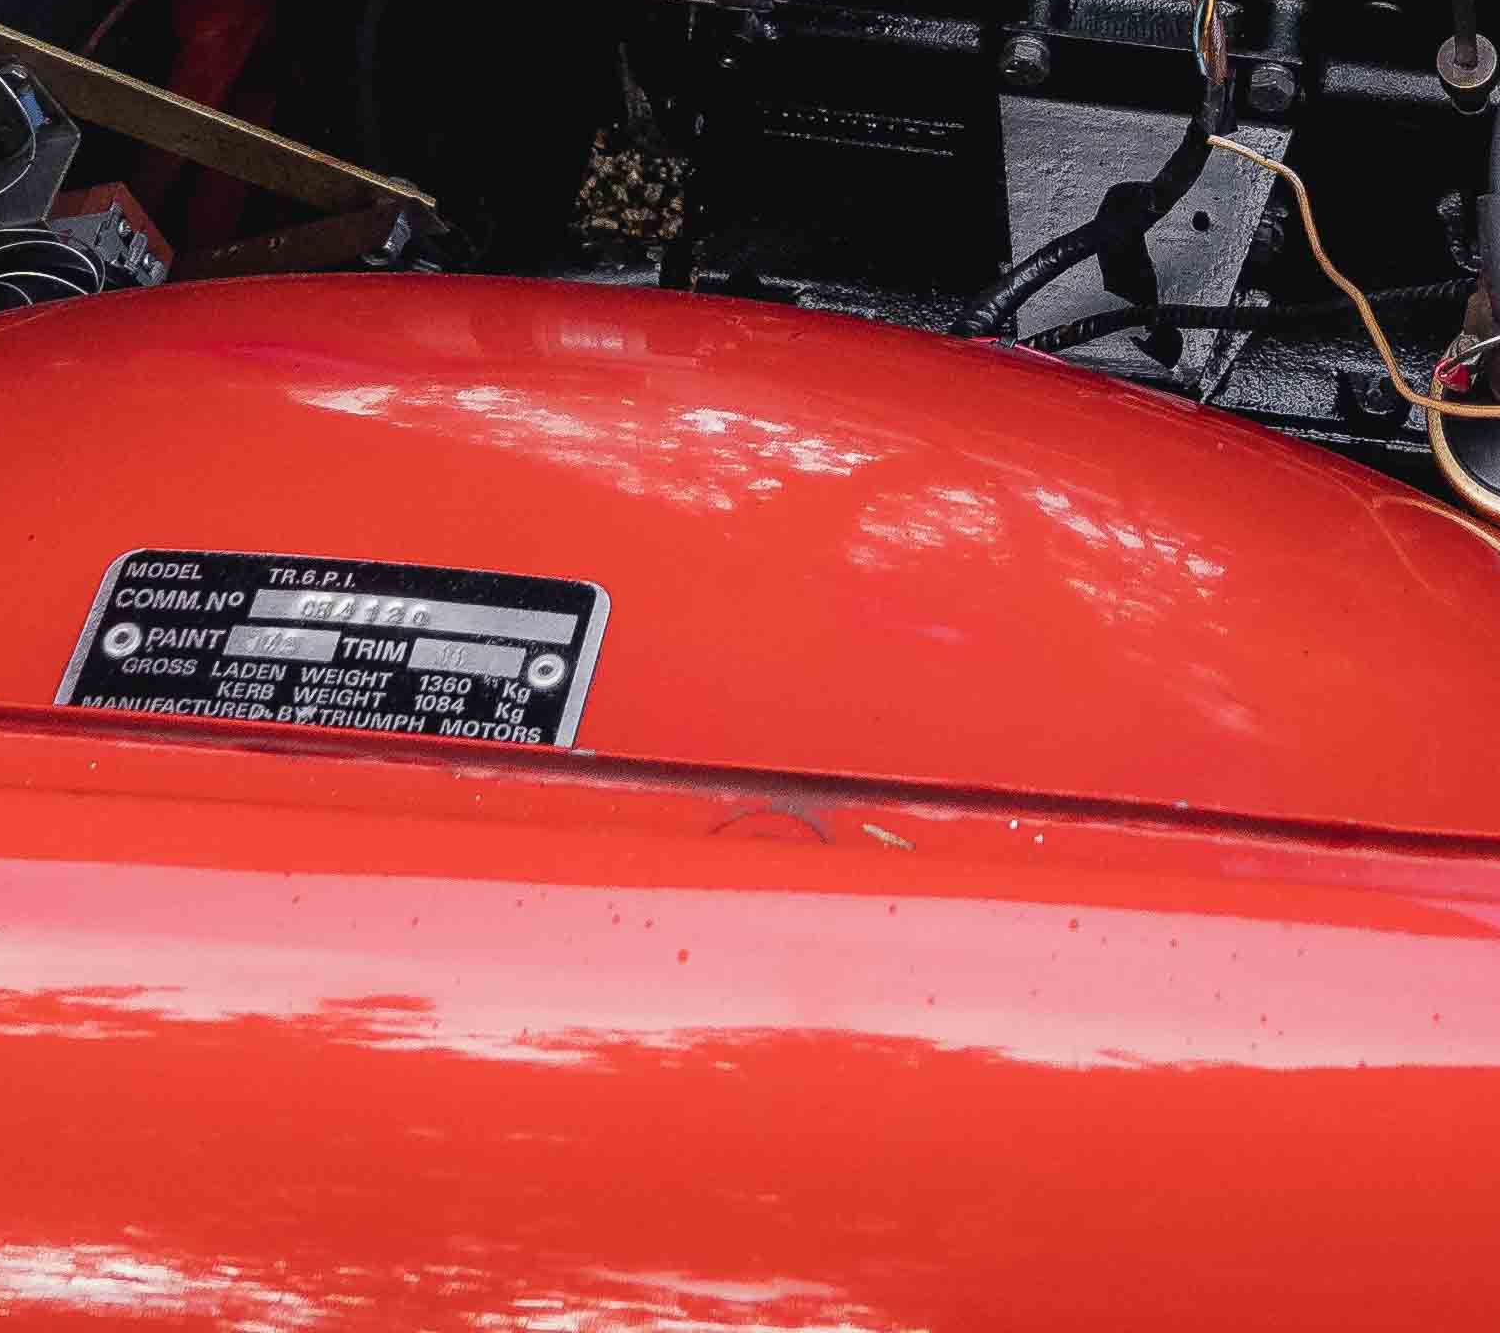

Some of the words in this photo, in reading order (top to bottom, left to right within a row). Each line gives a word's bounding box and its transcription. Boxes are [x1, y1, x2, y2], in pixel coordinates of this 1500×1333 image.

[125, 562, 204, 580] MODEL
[145, 626, 227, 650] PAINT
[342, 636, 409, 662] TRIM
[121, 656, 198, 676] GROSS
[211, 659, 288, 682] LADEN
[300, 665, 394, 689] WEIGHT
[418, 673, 473, 695] 1360
[501, 682, 532, 705] Kg
[215, 680, 276, 702] KERB
[292, 685, 387, 710] WEIGHT
[412, 693, 466, 716] 1084
[495, 701, 526, 725] Kg
[80, 694, 264, 720] MANUFACTURED
[318, 708, 427, 733] TRIUMPH
[438, 718, 543, 744] MOTORS
